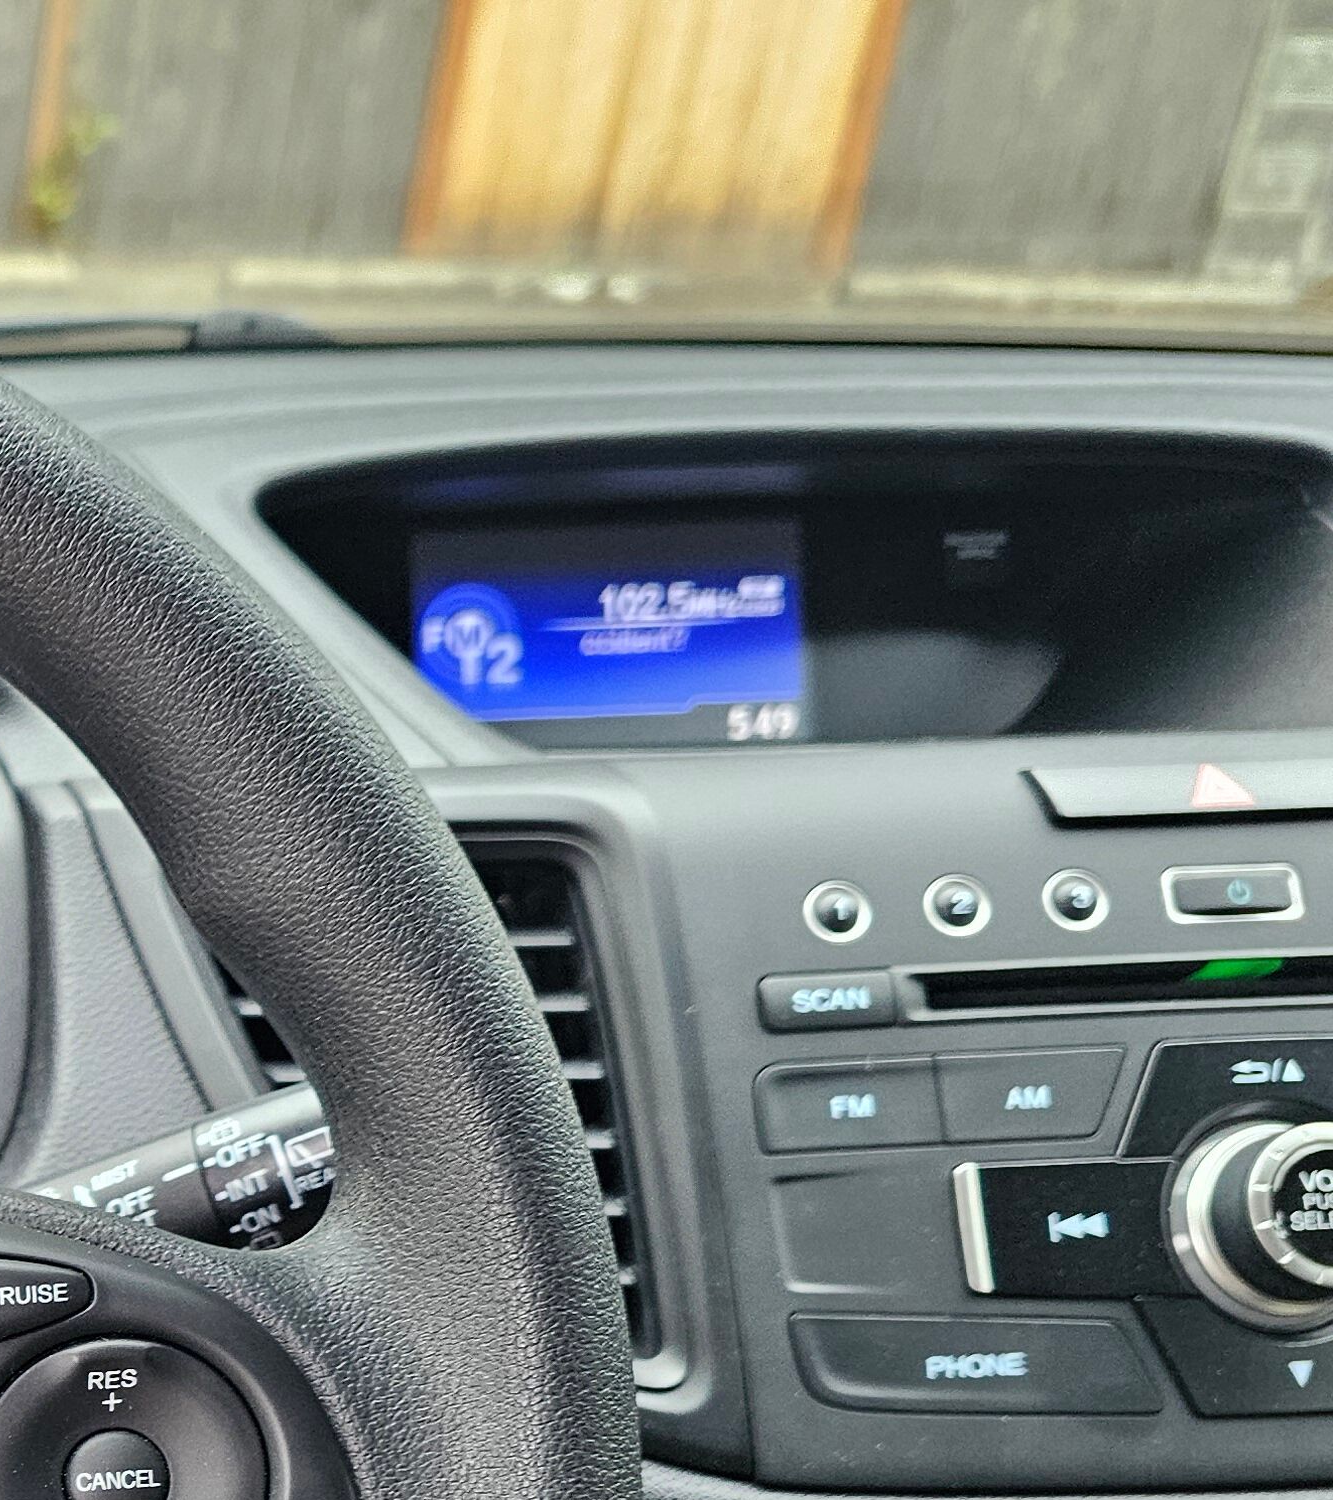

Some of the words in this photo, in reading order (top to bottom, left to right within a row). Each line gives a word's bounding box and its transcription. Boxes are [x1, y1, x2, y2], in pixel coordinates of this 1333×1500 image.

[833, 898, 850, 922] 1
[951, 892, 974, 915] 2
[1070, 885, 1094, 910] 3
[791, 986, 871, 1014] SCAN
[829, 1094, 877, 1121] FM
[1004, 1084, 1053, 1111] AM
[215, 1132, 268, 1169] OFF
[225, 1168, 270, 1202] INT
[294, 1166, 336, 1195] REA
[1298, 1168, 1333, 1193] VO
[105, 1186, 155, 1217] OFF
[240, 1203, 282, 1233] ON
[87, 1368, 139, 1390] RES
[925, 1351, 1029, 1380] PHONE
[75, 1469, 161, 1492] CANCEL
